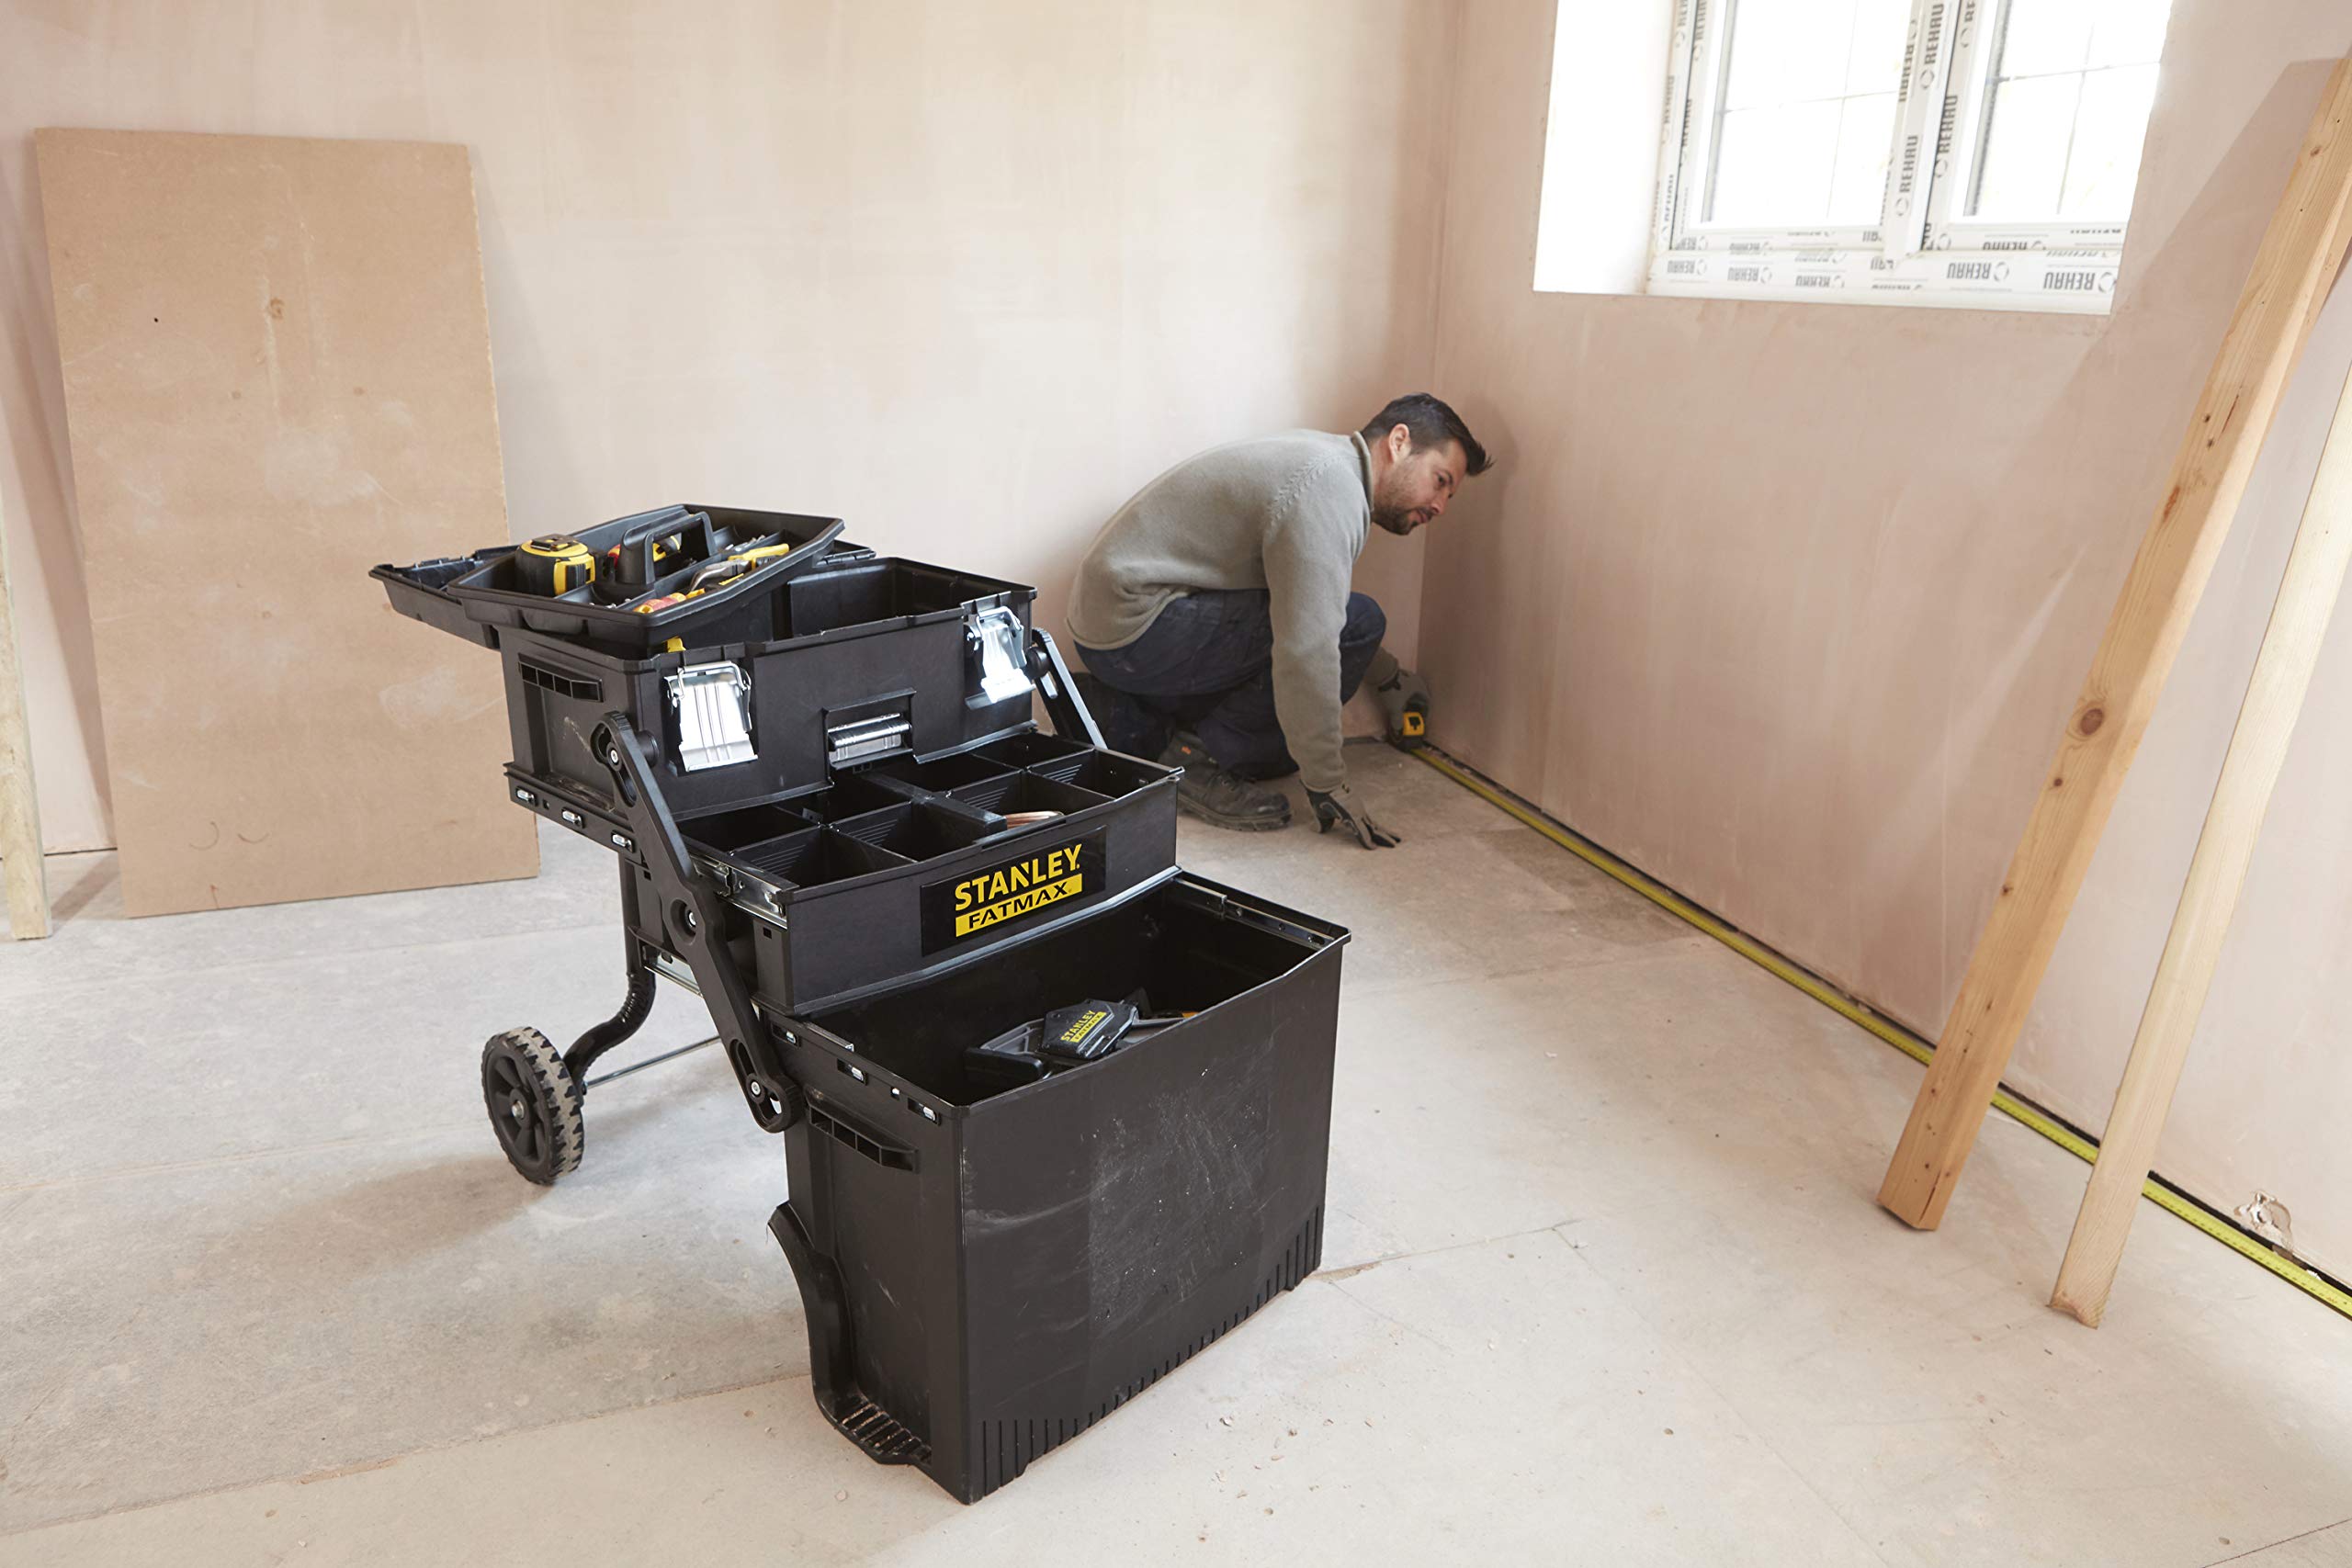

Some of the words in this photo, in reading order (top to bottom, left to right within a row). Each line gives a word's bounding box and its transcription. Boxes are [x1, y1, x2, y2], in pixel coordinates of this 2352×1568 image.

[1924, 3, 1944, 64] REHAU
[1939, 96, 1958, 154] REHAU
[1899, 135, 1918, 193] REHAU
[1667, 260, 1696, 274] REHAU
[1727, 267, 1759, 282] REHAU
[1946, 262, 1992, 279] REHAU
[2043, 271, 2096, 290] REHAU
[955, 843, 1082, 911] STANLEY
[969, 882, 1069, 929] FATMAX
[1060, 1010, 1096, 1042] STANLEY
